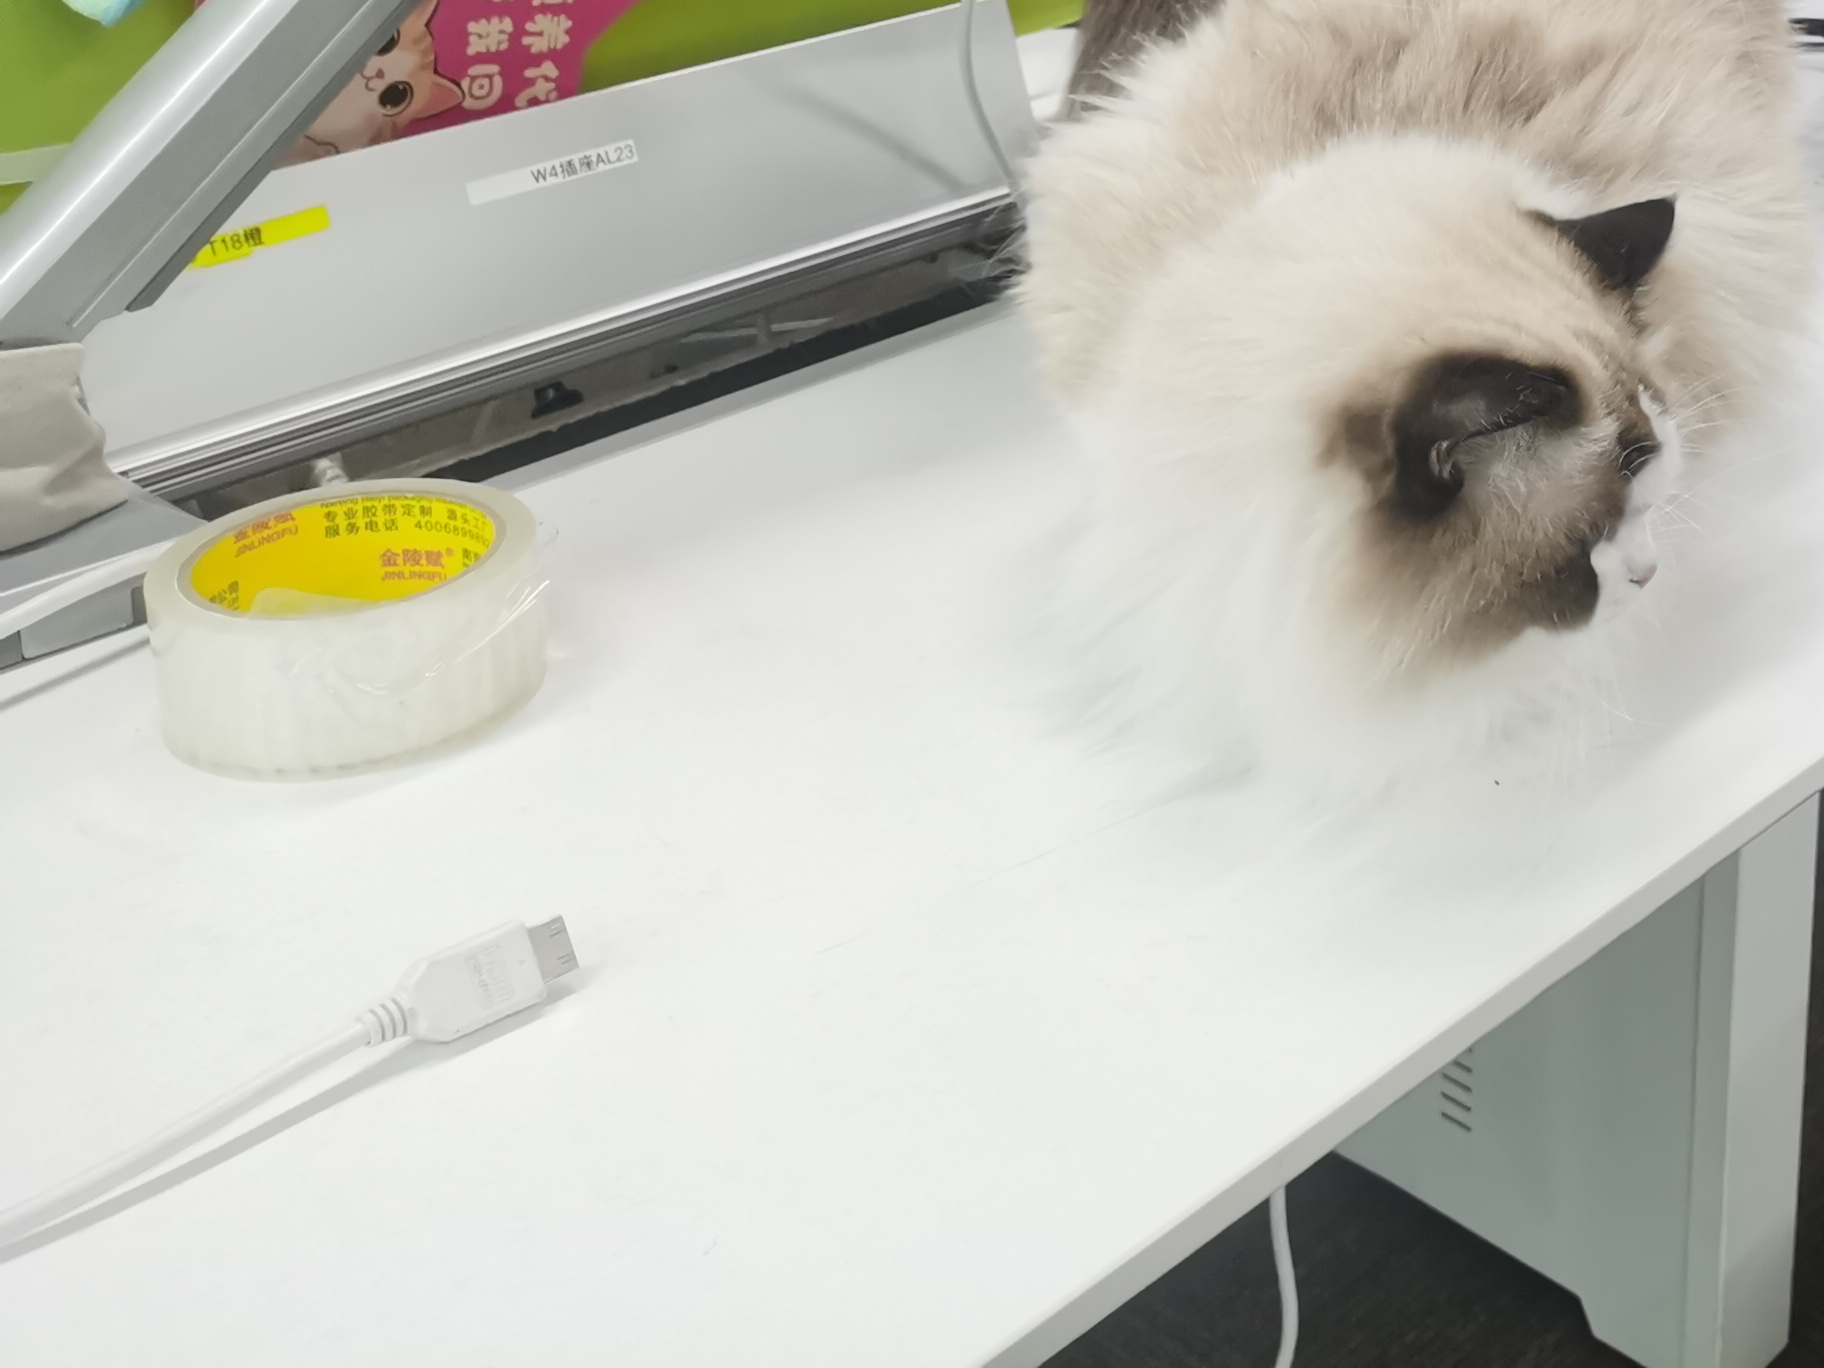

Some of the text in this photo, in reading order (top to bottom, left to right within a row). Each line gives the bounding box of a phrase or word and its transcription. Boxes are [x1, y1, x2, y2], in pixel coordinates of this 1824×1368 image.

[530, 143, 636, 185] W4插座AL23
[323, 503, 433, 523] 专业胶带定制
[325, 518, 398, 538] 服务电话
